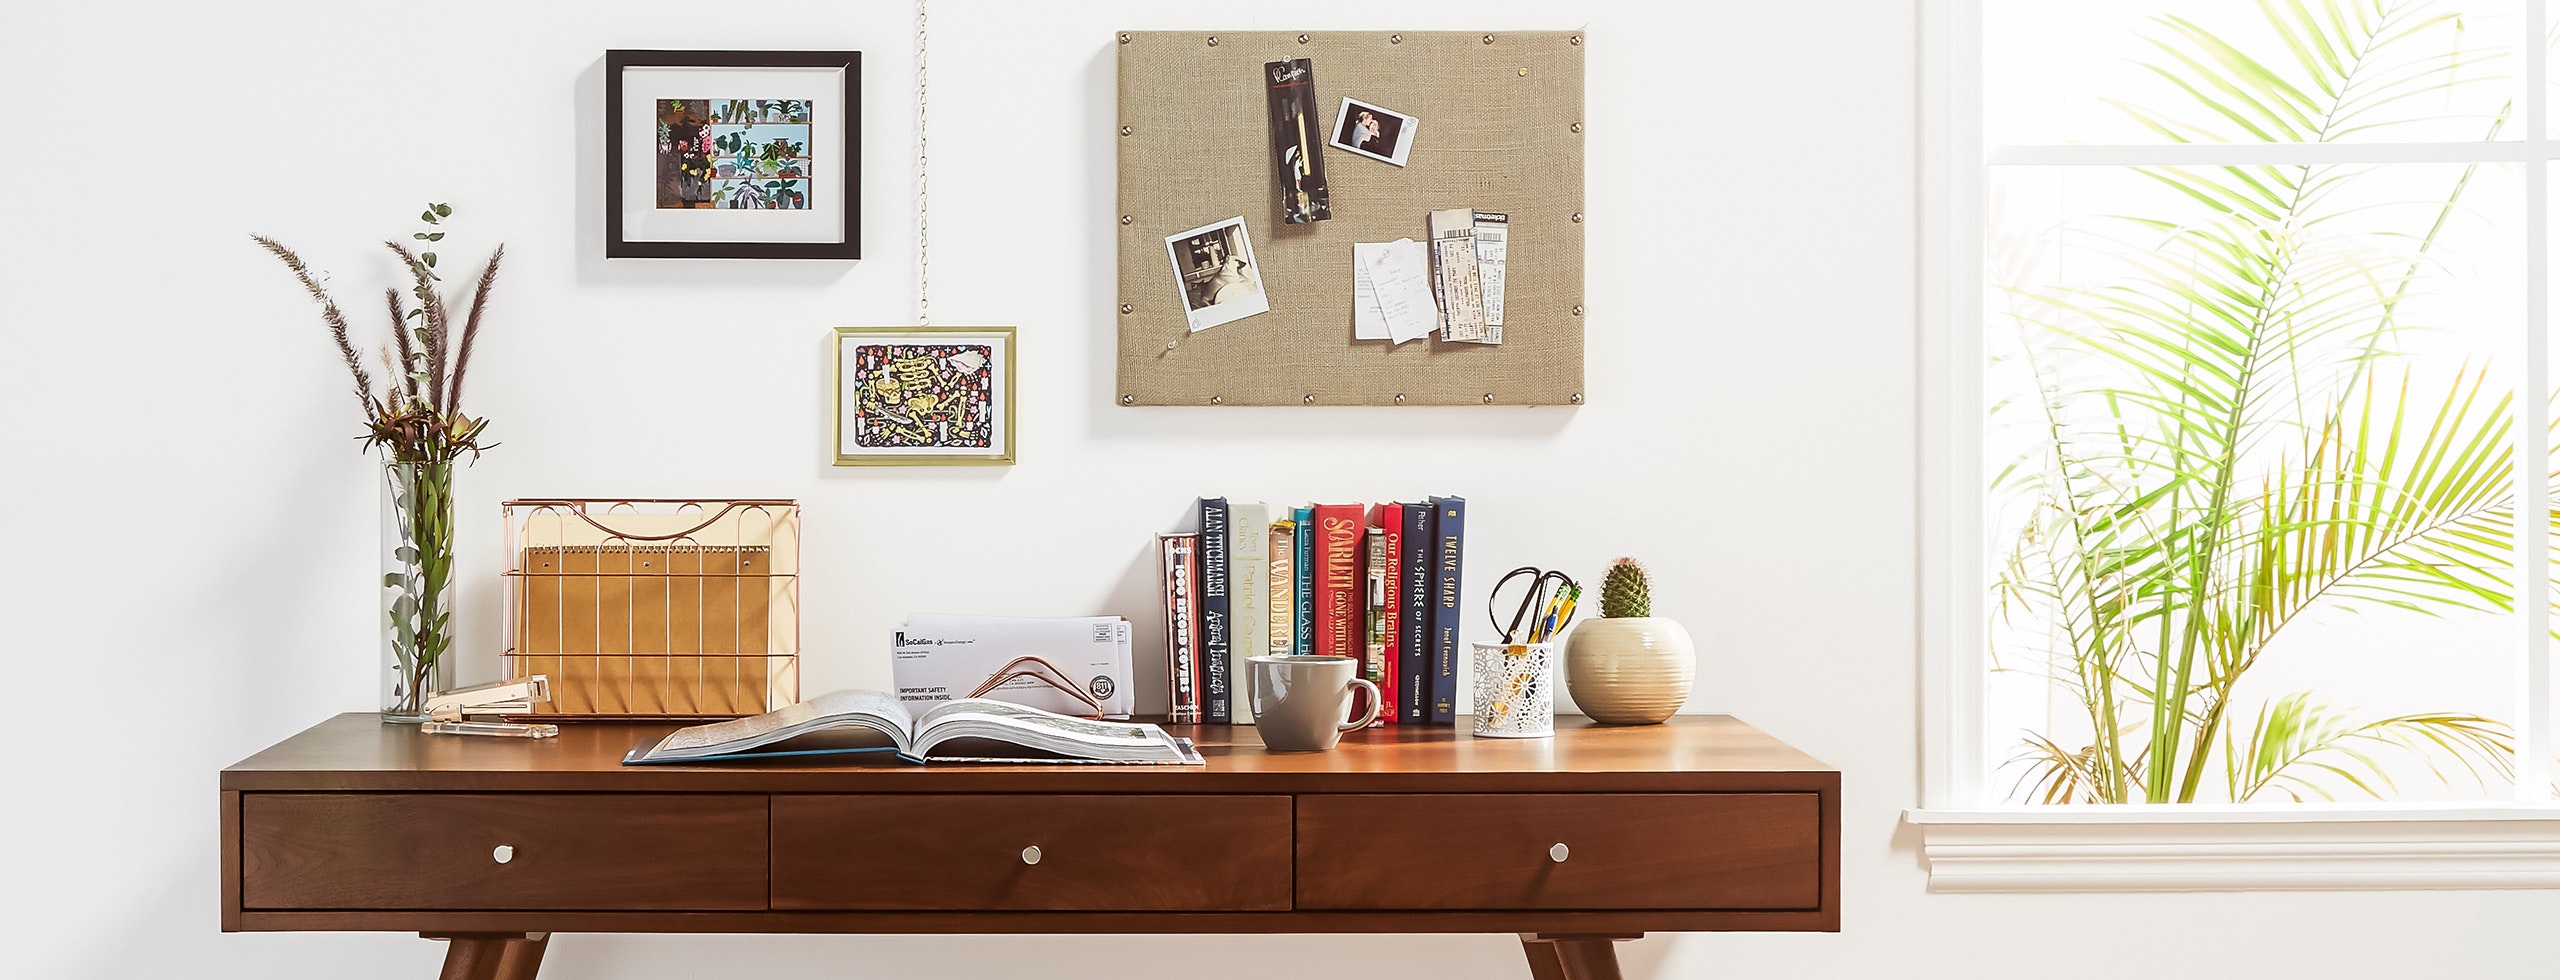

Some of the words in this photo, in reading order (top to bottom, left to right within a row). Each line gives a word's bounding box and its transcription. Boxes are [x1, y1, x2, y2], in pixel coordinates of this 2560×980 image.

[1205, 507, 1224, 532] ALAN
[1237, 517, 1248, 552] Clancy
[1277, 538, 1289, 556] The
[1303, 547, 1311, 571] Furman
[1323, 516, 1355, 589] SCARLETT
[1387, 533, 1398, 557] Our
[1416, 549, 1424, 563] THE
[1443, 535, 1457, 572] TWELVE
[1174, 564, 1187, 597] 1000
[1206, 533, 1225, 597] TITCHMARSH
[1242, 565, 1256, 611] Patriot
[1302, 574, 1312, 598] THE
[1385, 558, 1399, 611] Religious
[1413, 566, 1425, 607] SPHERE
[1442, 577, 1456, 608] SHARP
[1335, 591, 1347, 617] GONE
[1414, 611, 1422, 621] OF
[1175, 598, 1188, 645] RECORD
[1207, 610, 1227, 646] Animal
[1301, 601, 1312, 640] GLASS
[1335, 618, 1346, 641] WITH
[1386, 612, 1397, 647] Brains
[1443, 626, 1453, 644] Janet
[905, 638, 933, 646] SoCalGas
[1414, 625, 1422, 657] SECRETS
[1095, 682, 1108, 690] 811
[1177, 648, 1190, 693] COVERS
